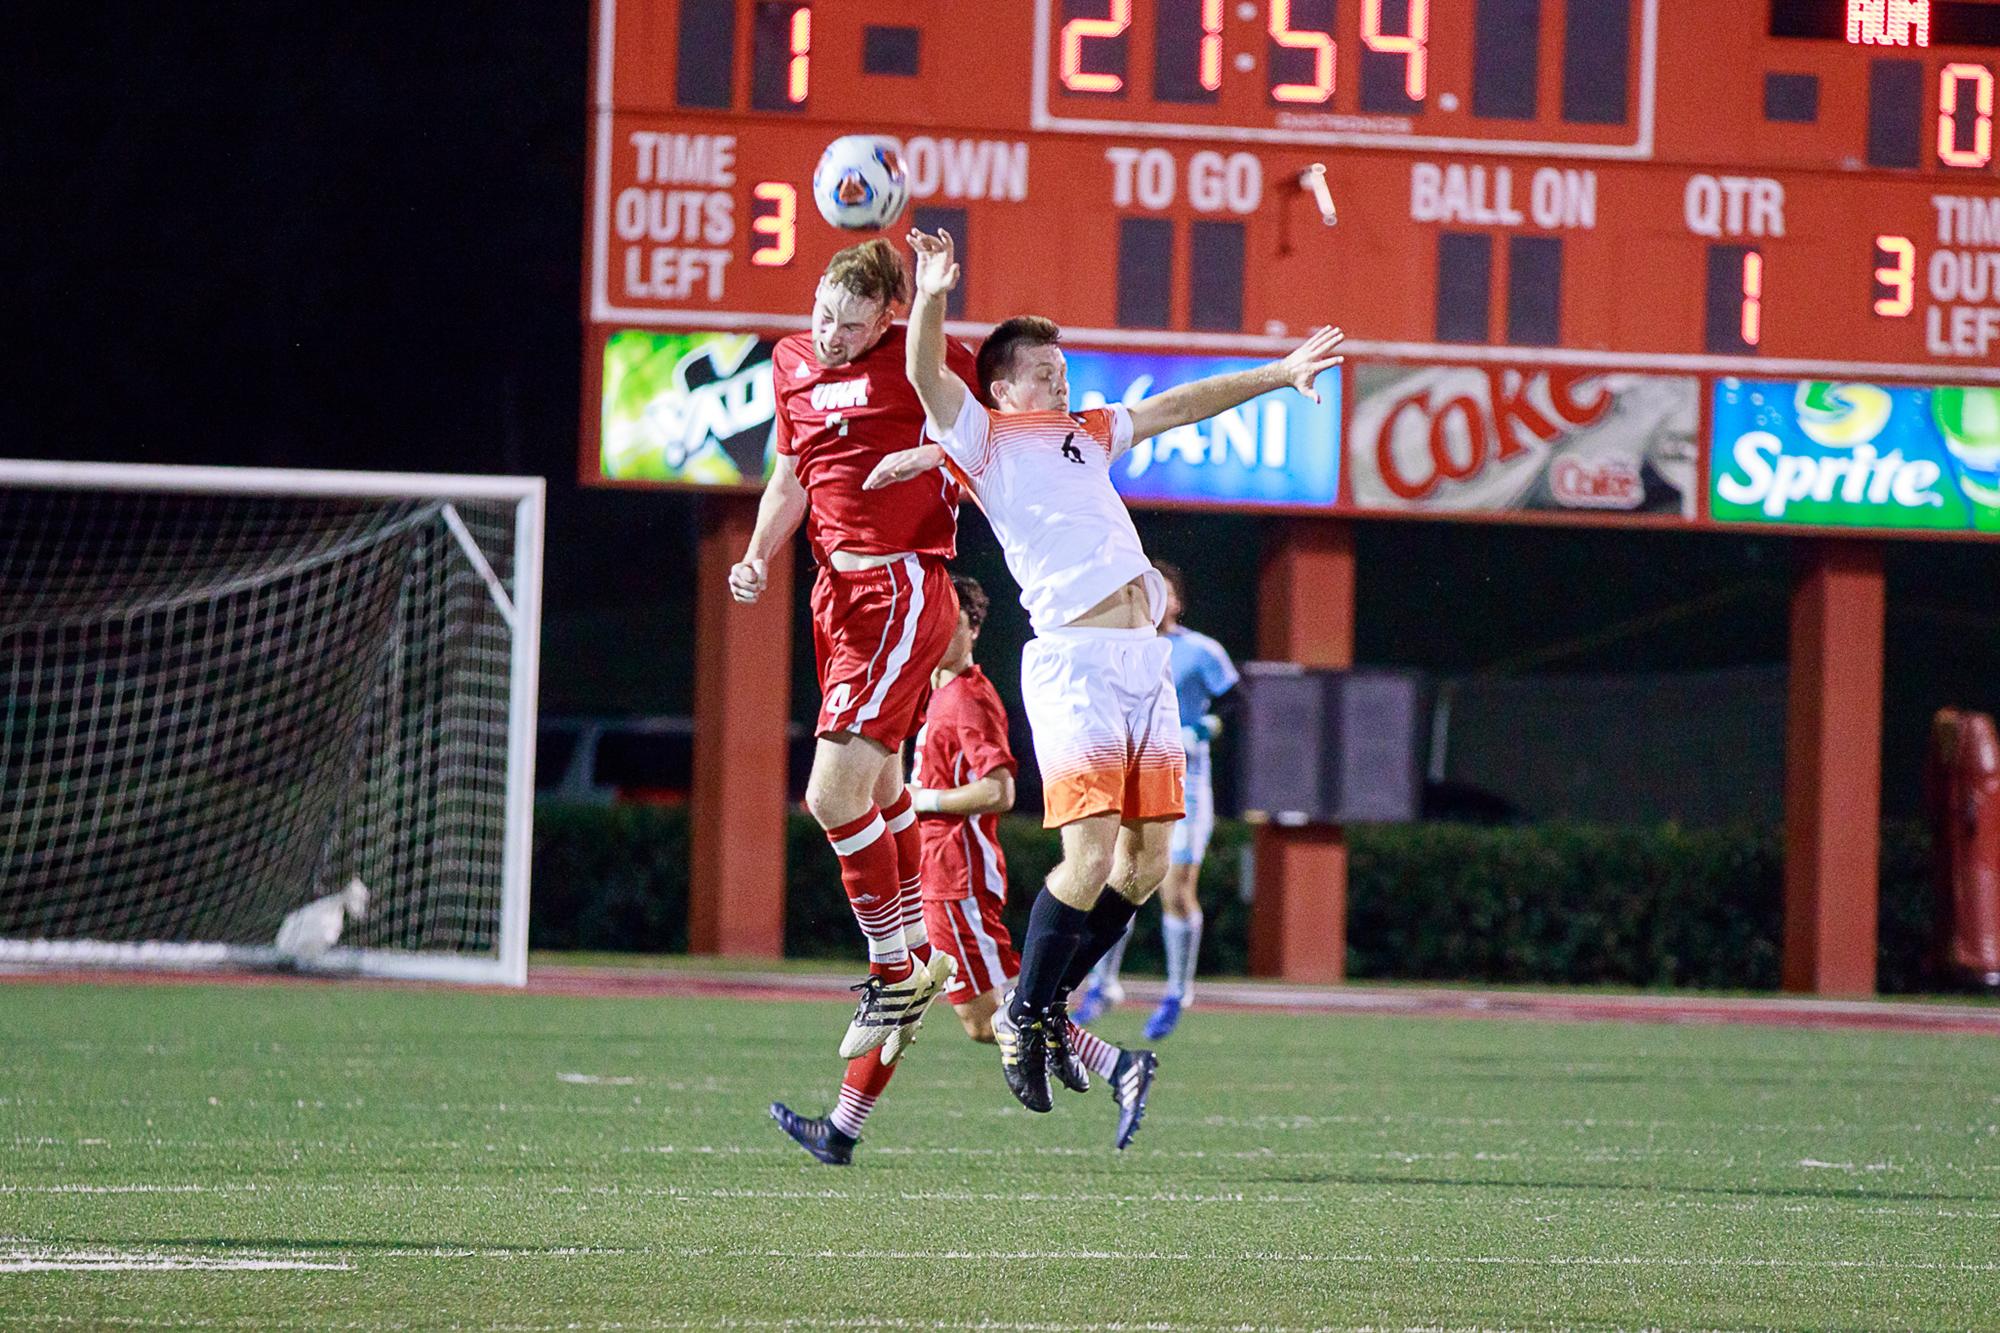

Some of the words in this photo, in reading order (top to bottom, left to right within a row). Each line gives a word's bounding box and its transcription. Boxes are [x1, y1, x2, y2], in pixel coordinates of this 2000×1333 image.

[788, 7, 812, 102] 1
[1937, 62, 1994, 168] 0
[630, 131, 737, 187] TIME
[903, 138, 1029, 200] OWN
[1105, 147, 1177, 210] TO
[1188, 150, 1263, 215] GO
[615, 187, 735, 243] OUTS
[752, 181, 797, 267] 3
[1410, 162, 1523, 226] BALL
[1531, 167, 1597, 229] ON
[1683, 175, 1786, 238] QTR
[625, 246, 733, 301] LEFT
[1741, 251, 1763, 345] 1
[1873, 234, 1917, 318] 3
[1716, 430, 1944, 517] Sprite
